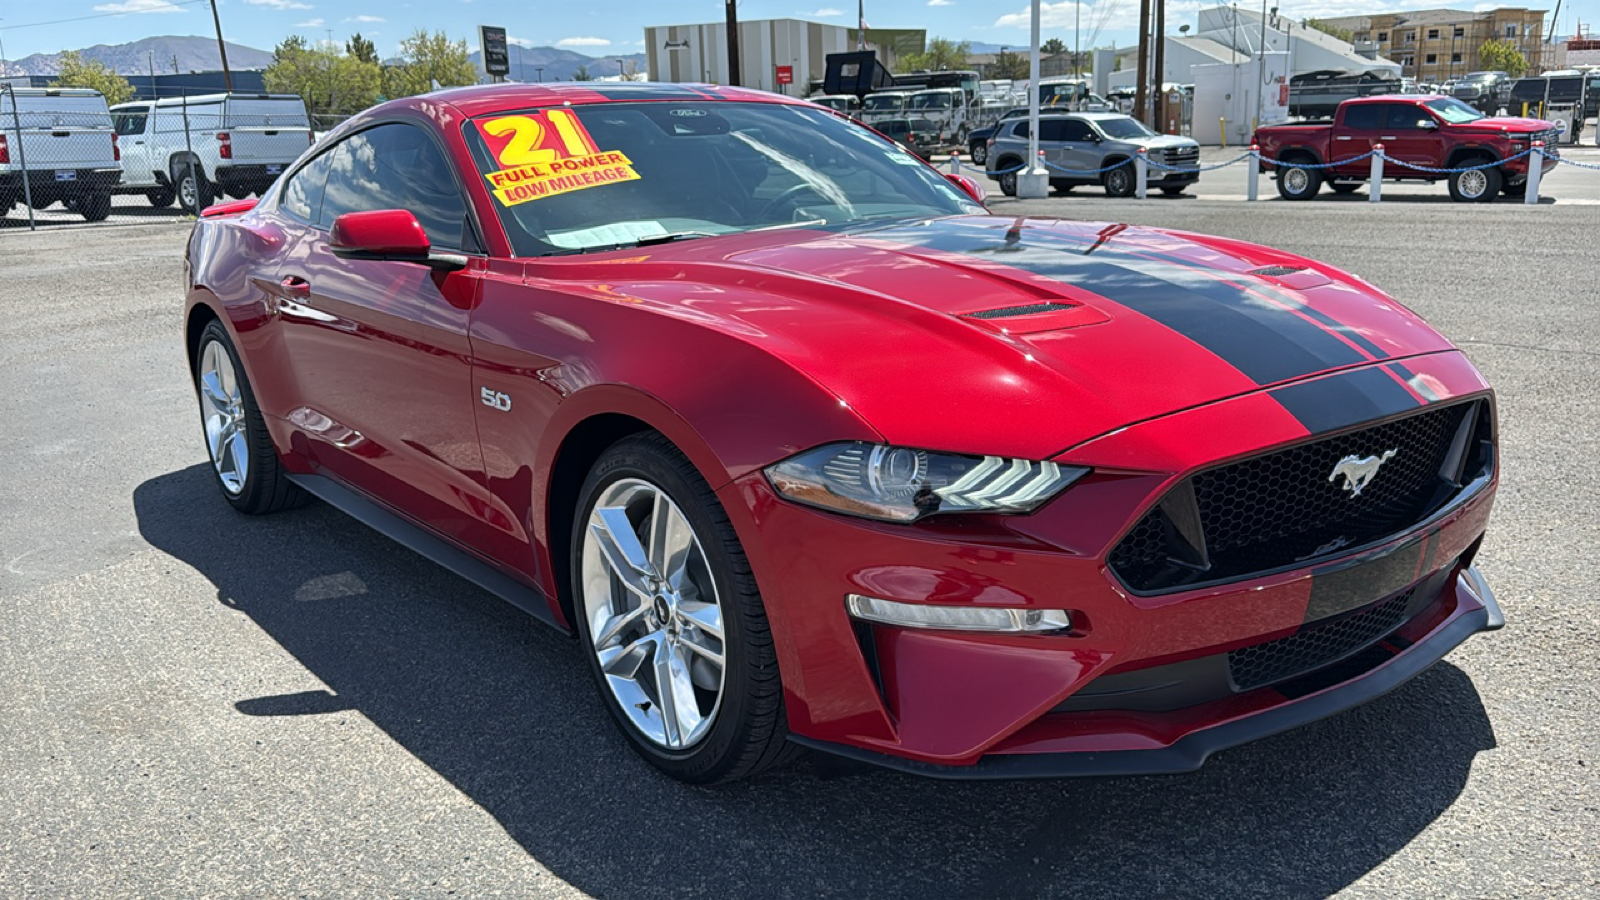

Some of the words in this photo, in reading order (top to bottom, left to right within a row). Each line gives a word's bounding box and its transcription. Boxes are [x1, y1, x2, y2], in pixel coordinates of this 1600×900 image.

[483, 109, 592, 166] 21
[492, 166, 546, 186] FULL
[549, 153, 624, 173] POWER
[503, 182, 548, 202] LOW
[549, 167, 631, 191] MILEAGE
